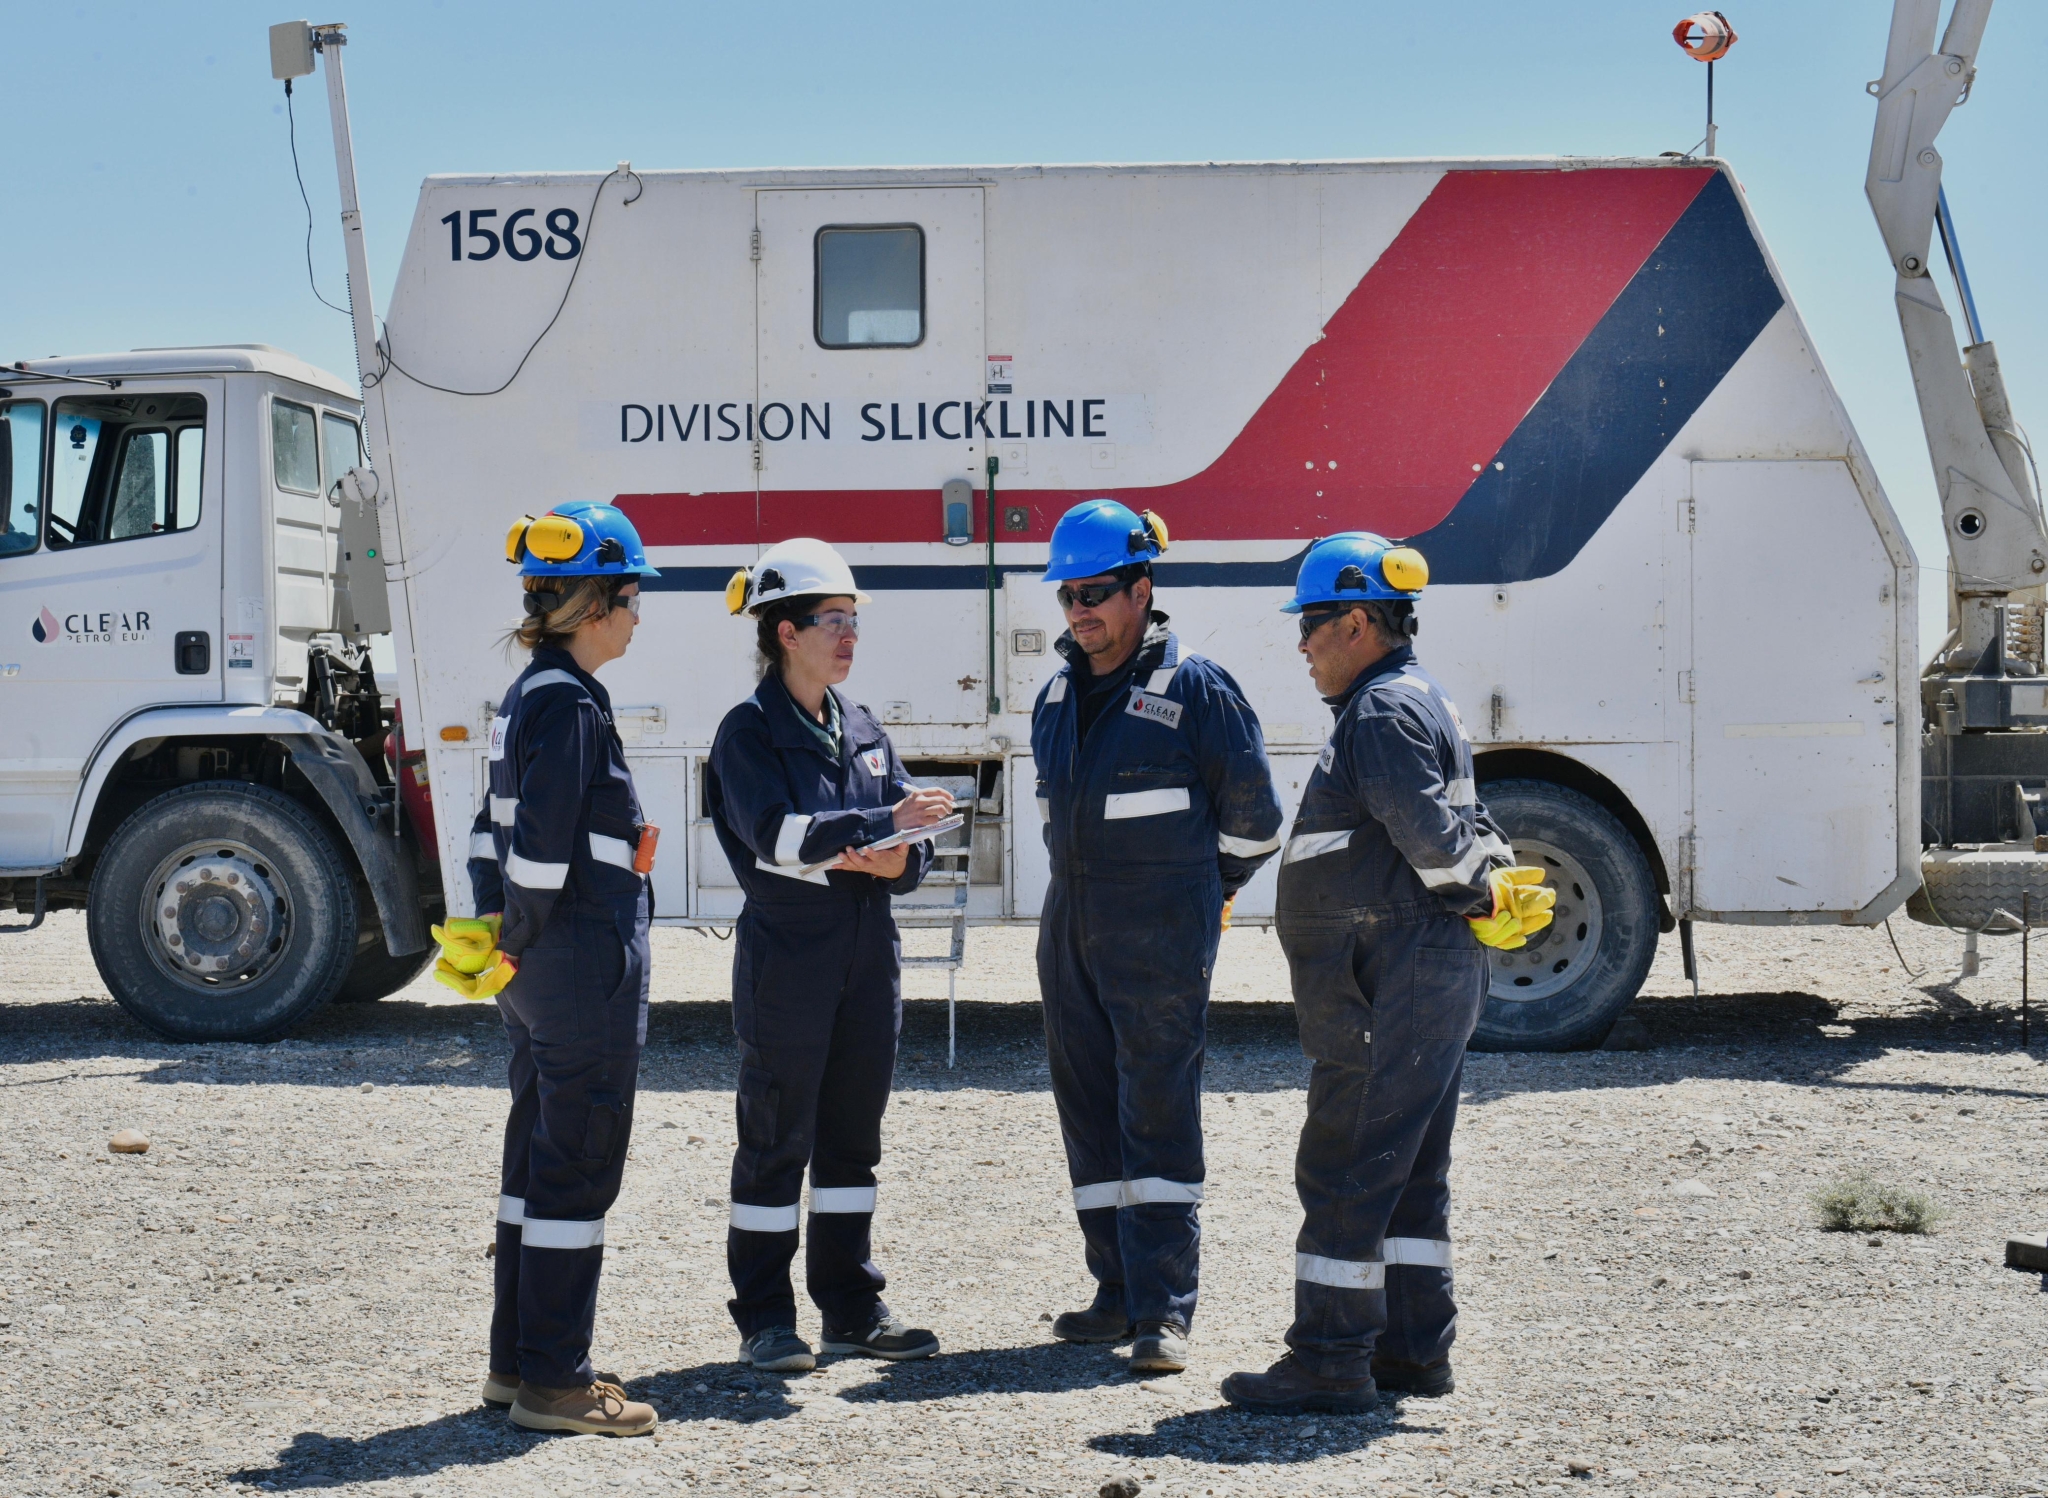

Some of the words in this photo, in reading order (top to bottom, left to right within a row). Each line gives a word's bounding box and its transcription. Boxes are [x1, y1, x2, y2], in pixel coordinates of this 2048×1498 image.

[441, 207, 581, 262] 1568
[621, 402, 831, 443] DIVISION
[860, 398, 1107, 442] SLICKLINE
[65, 611, 150, 633] CLEAR
[67, 632, 145, 643] ETROEU
[1145, 703, 1176, 719] CLEAR
